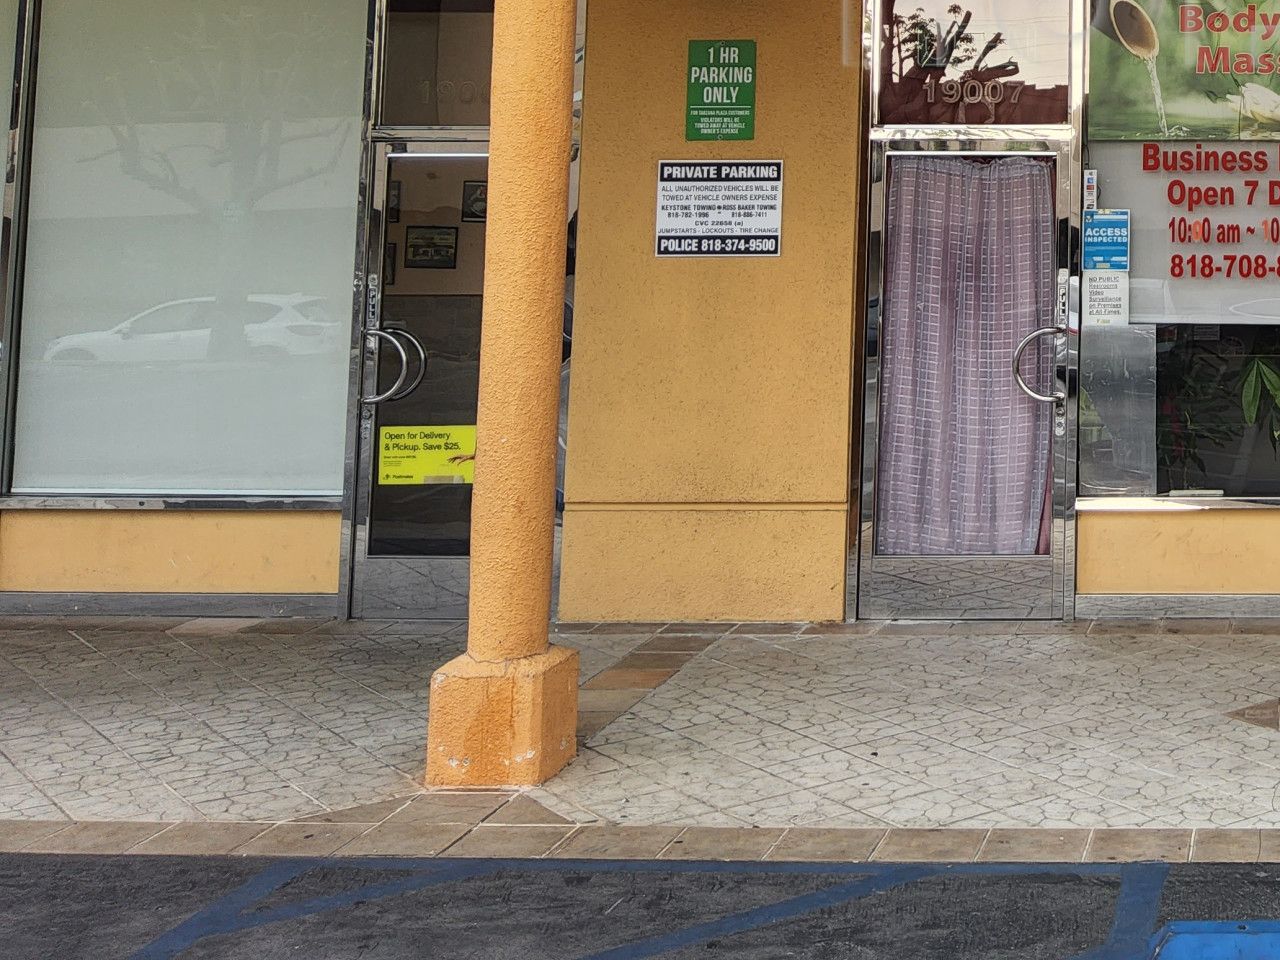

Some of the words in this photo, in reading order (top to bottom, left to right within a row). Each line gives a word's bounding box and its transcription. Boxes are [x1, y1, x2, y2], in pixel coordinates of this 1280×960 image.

[708, 47, 714, 63] 1
[720, 47, 739, 63] HR
[691, 67, 752, 83] PARKING
[703, 87, 739, 103] ONLY
[922, 80, 1025, 104] 19007
[1142, 143, 1269, 172] Business
[663, 166, 718, 179] PRIVATE
[721, 165, 778, 178] PARKING
[1167, 179, 1235, 212] Open
[1244, 180, 1260, 205] 7
[1085, 228, 1128, 236] ACCESS
[1168, 217, 1211, 243] 10:00
[1216, 223, 1241, 243] am
[660, 239, 698, 251] POLICE
[701, 239, 776, 251] 818-374-9500
[384, 432, 406, 441] Open
[407, 431, 417, 440] for
[419, 431, 451, 441] Delivery
[384, 443, 391, 451] &
[392, 442, 421, 452] Pickup.
[422, 442, 442, 451] Save
[443, 442, 462, 451] $25.
